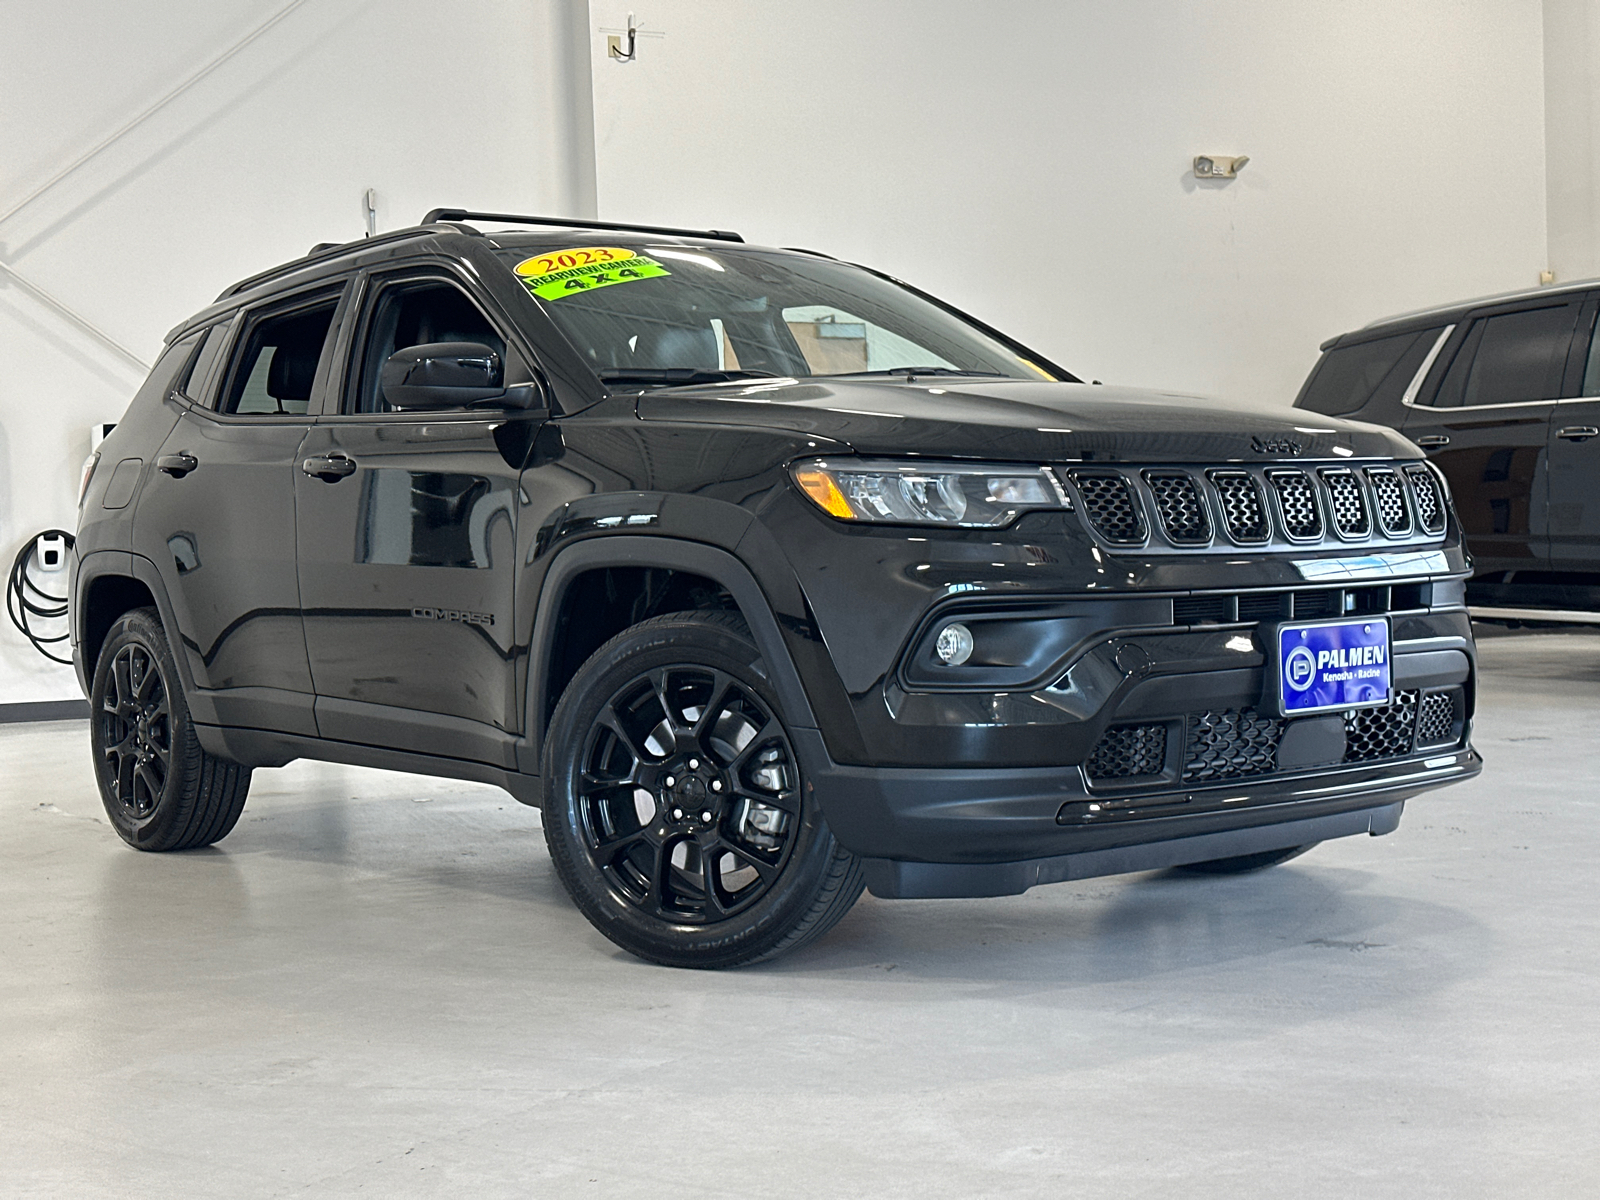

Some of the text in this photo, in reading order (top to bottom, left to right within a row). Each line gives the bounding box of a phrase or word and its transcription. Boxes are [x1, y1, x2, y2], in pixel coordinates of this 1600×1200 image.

[529, 256, 655, 287] REARVIEW CAMERA
[537, 249, 614, 273] 2023
[1250, 435, 1302, 456] Jeep
[412, 606, 494, 626] COMPASS
[1317, 645, 1385, 670] PALMEN
[1323, 669, 1381, 683] Kenosha Racine
